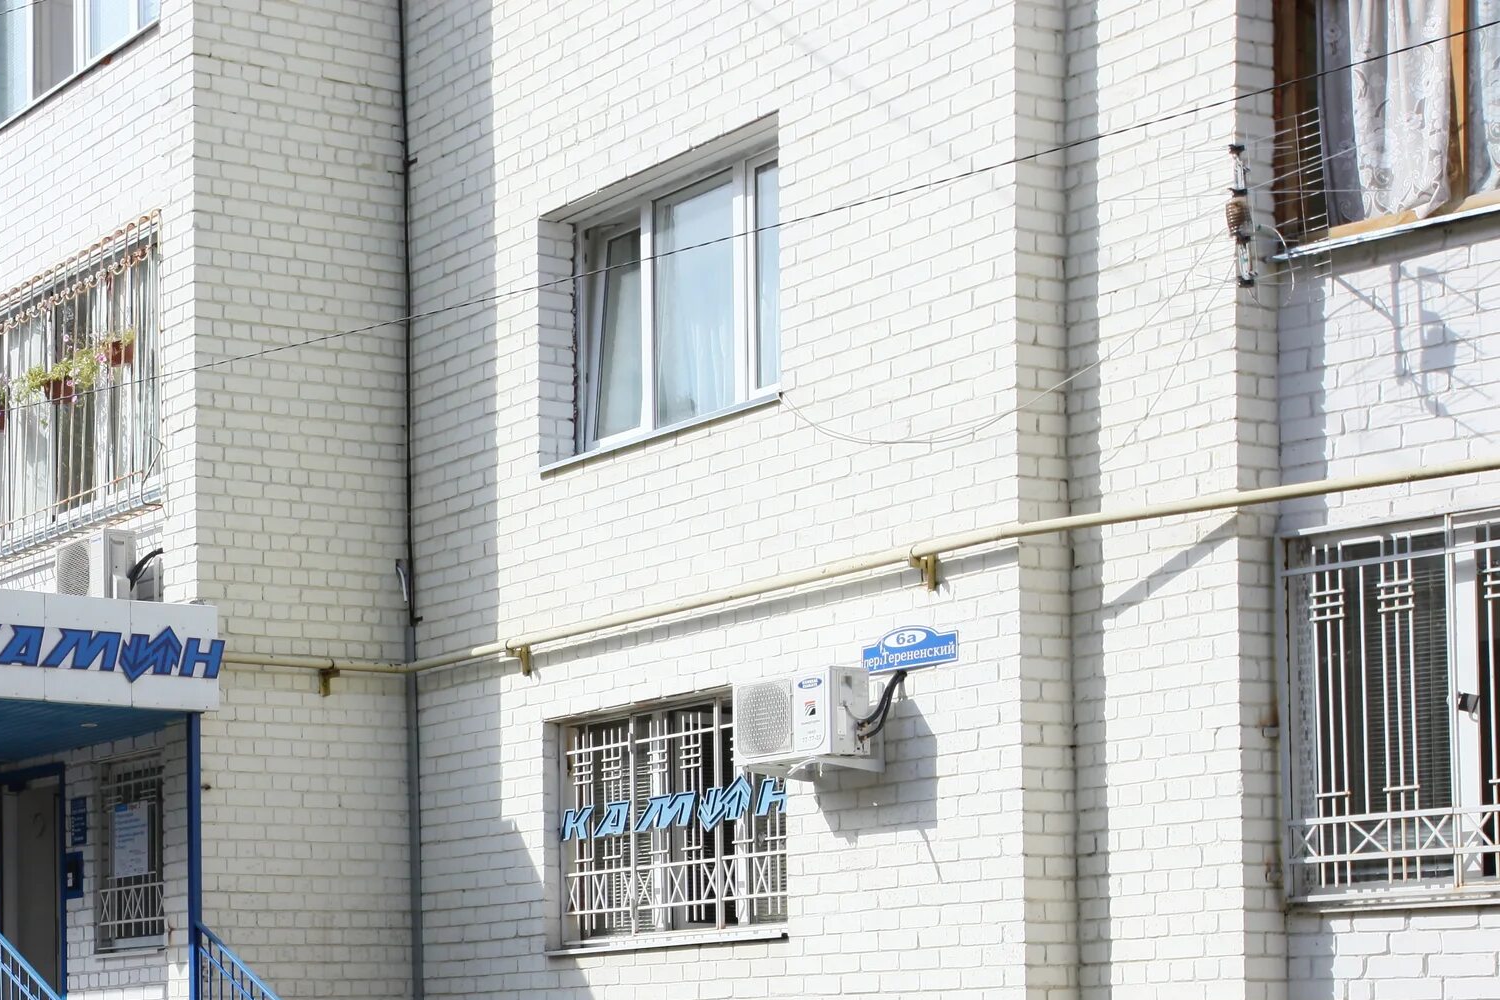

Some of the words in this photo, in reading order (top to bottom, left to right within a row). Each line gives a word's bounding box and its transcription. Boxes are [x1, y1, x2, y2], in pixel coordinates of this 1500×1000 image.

[896, 632, 917, 646] 6а
[882, 641, 955, 665] Терененский
[561, 773, 787, 842] КАМИН
